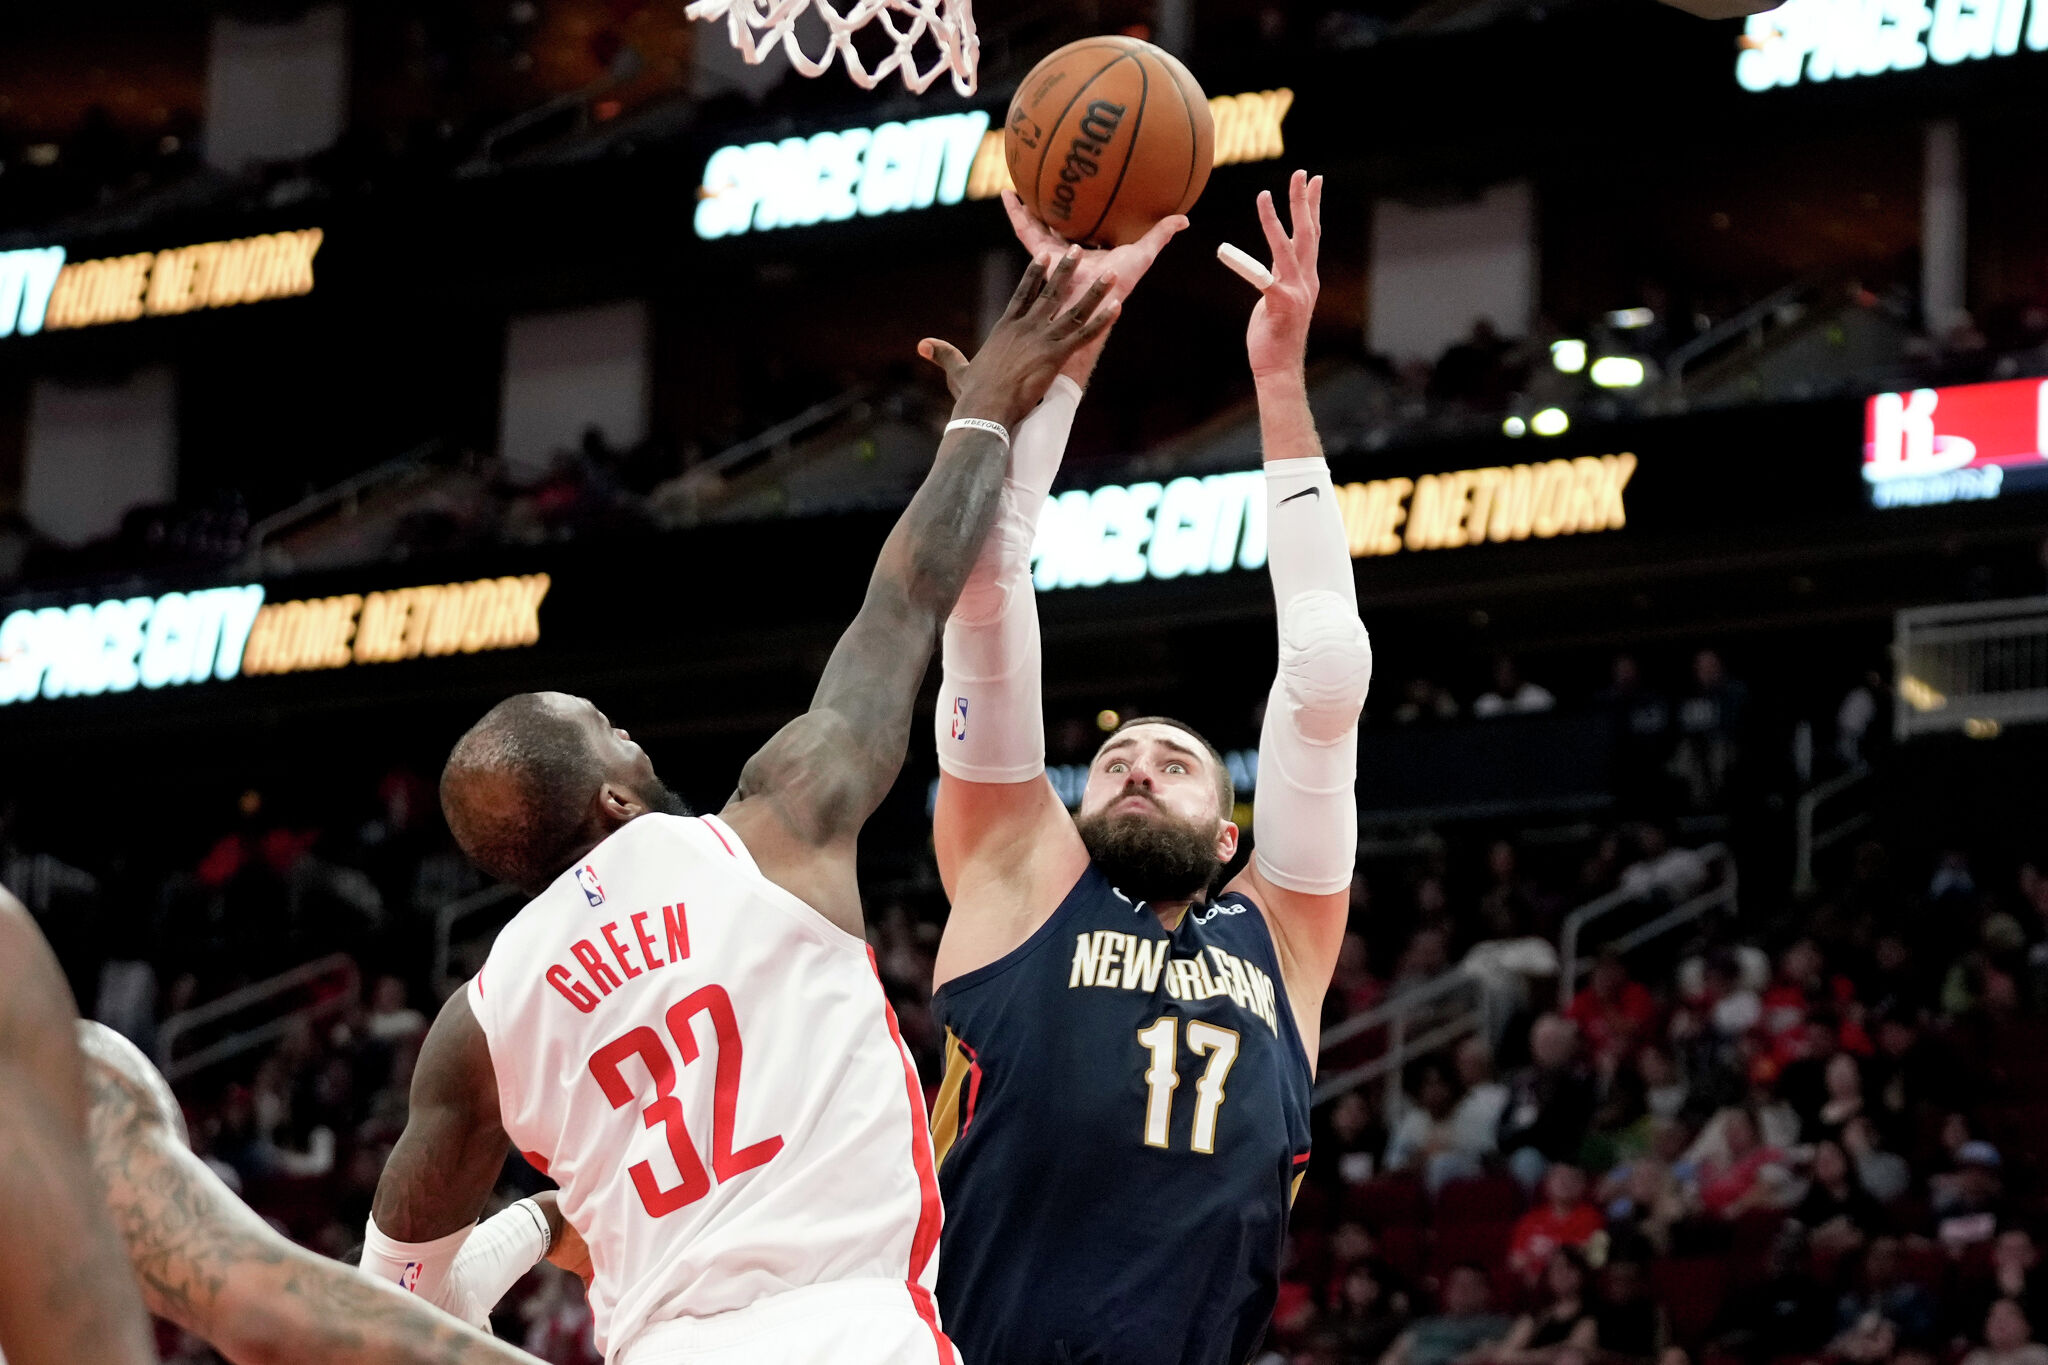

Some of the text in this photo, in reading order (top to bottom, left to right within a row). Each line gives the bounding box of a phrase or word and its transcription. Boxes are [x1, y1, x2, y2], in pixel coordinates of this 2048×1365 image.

[695, 128, 873, 240] SPACE
[857, 110, 991, 217] CITY
[1052, 100, 1127, 220] Wilson
[44, 252, 156, 331] HOME
[146, 227, 324, 318] NETWORK
[1404, 452, 1638, 550] NETWORK
[0, 571, 551, 706] SPACE CITY HOME NETWORK
[545, 902, 691, 1014] GREEN
[1068, 930, 1278, 1040] NEW ORLEANS
[588, 983, 785, 1219] 32
[1137, 1016, 1241, 1155] 17
